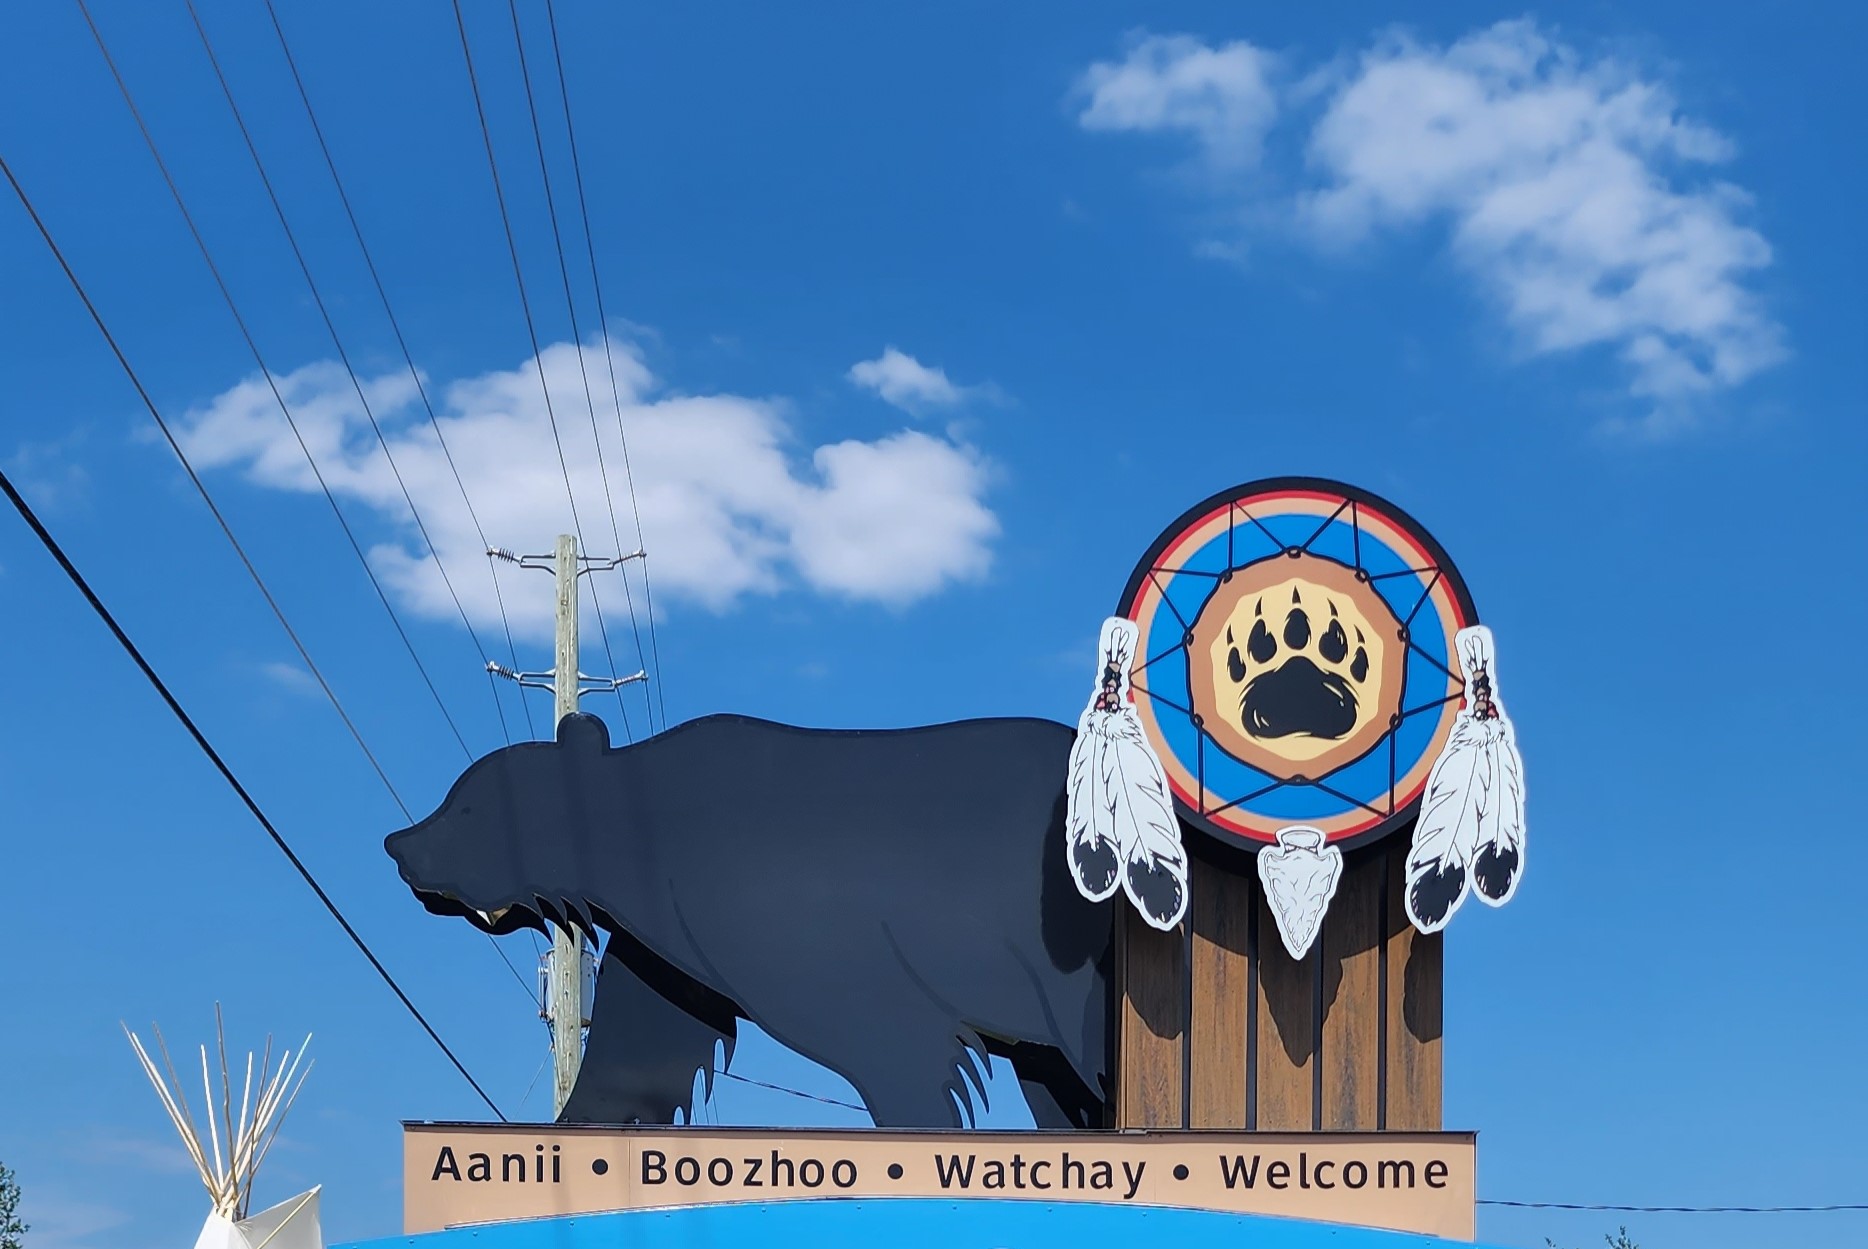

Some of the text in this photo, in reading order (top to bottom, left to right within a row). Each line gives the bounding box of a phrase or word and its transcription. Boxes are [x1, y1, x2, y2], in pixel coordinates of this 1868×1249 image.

[431, 1144, 1449, 1199] Aanii Boozhoo Watchay Welcome
